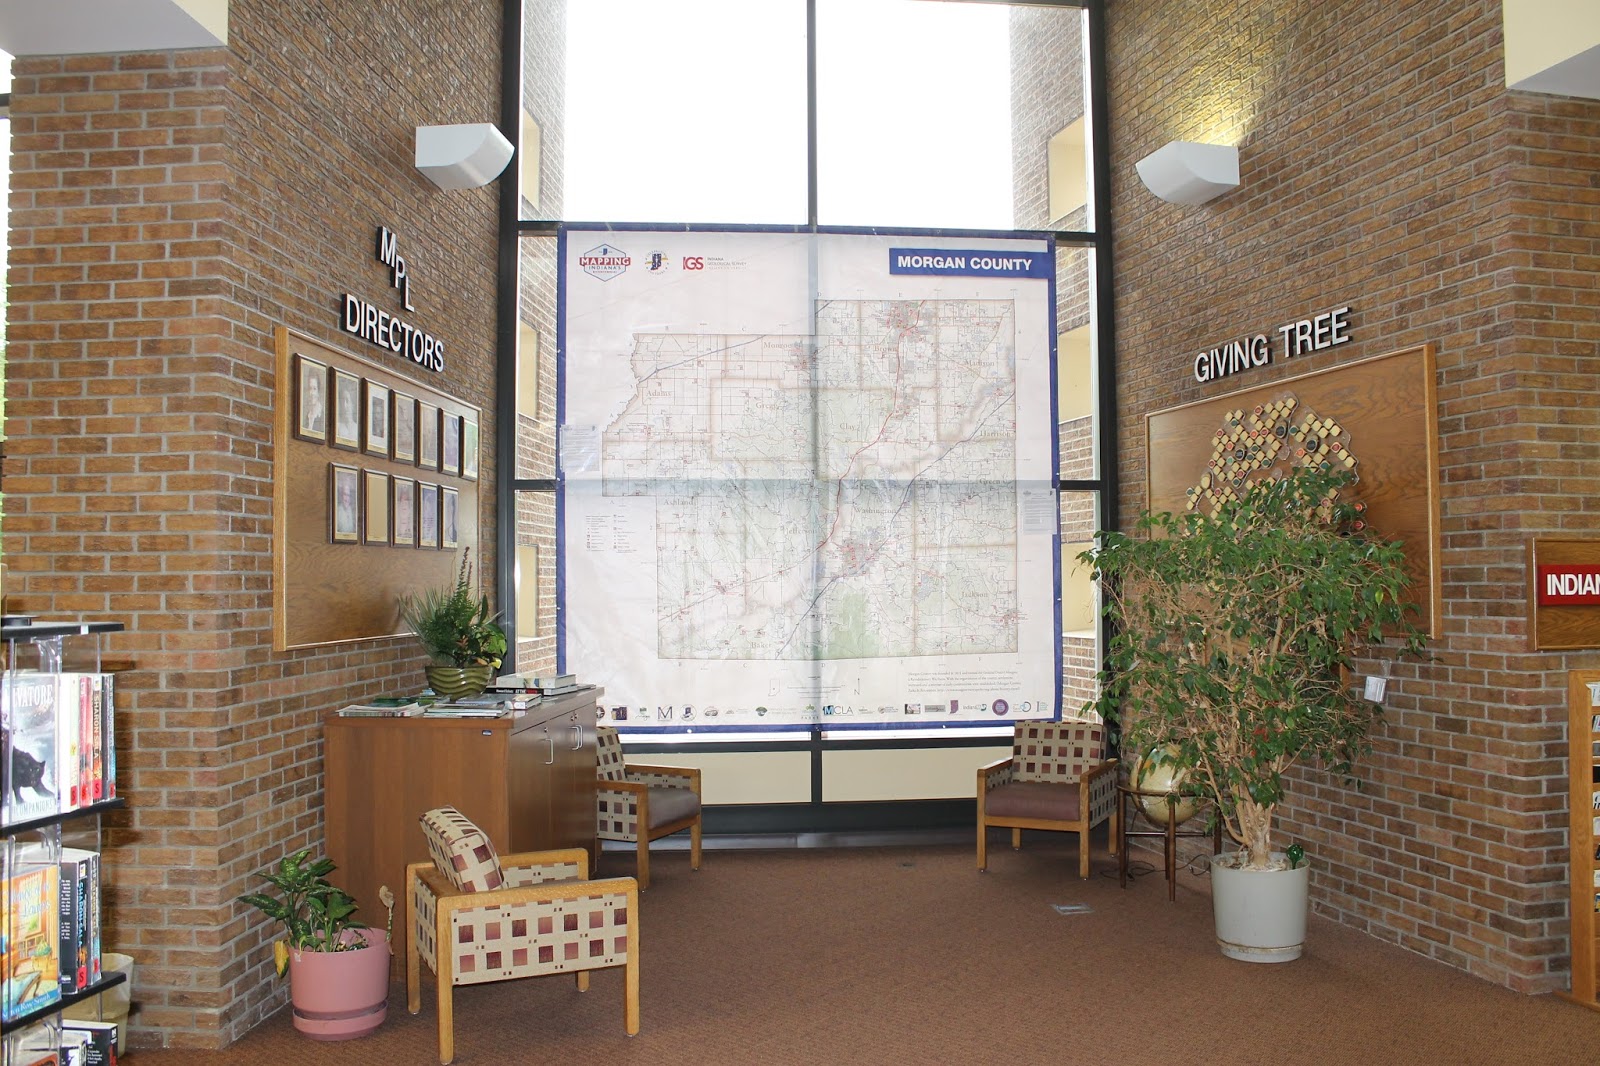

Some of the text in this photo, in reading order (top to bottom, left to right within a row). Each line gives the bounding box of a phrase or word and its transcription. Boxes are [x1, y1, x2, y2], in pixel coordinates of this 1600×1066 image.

[581, 257, 630, 266] MAPPING
[682, 256, 704, 270] IGS
[897, 256, 1032, 271] MORGAN COUNTY
[380, 226, 415, 312] MPL
[346, 293, 444, 372] DIRECTORS
[763, 341, 792, 349] Monroe
[1194, 306, 1350, 383] GIVING TREE
[964, 358, 995, 367] Madison
[647, 389, 671, 397] Adams
[663, 498, 694, 506] Ashland
[751, 641, 772, 649] Baker
[93, 695, 101, 732] SHARON
